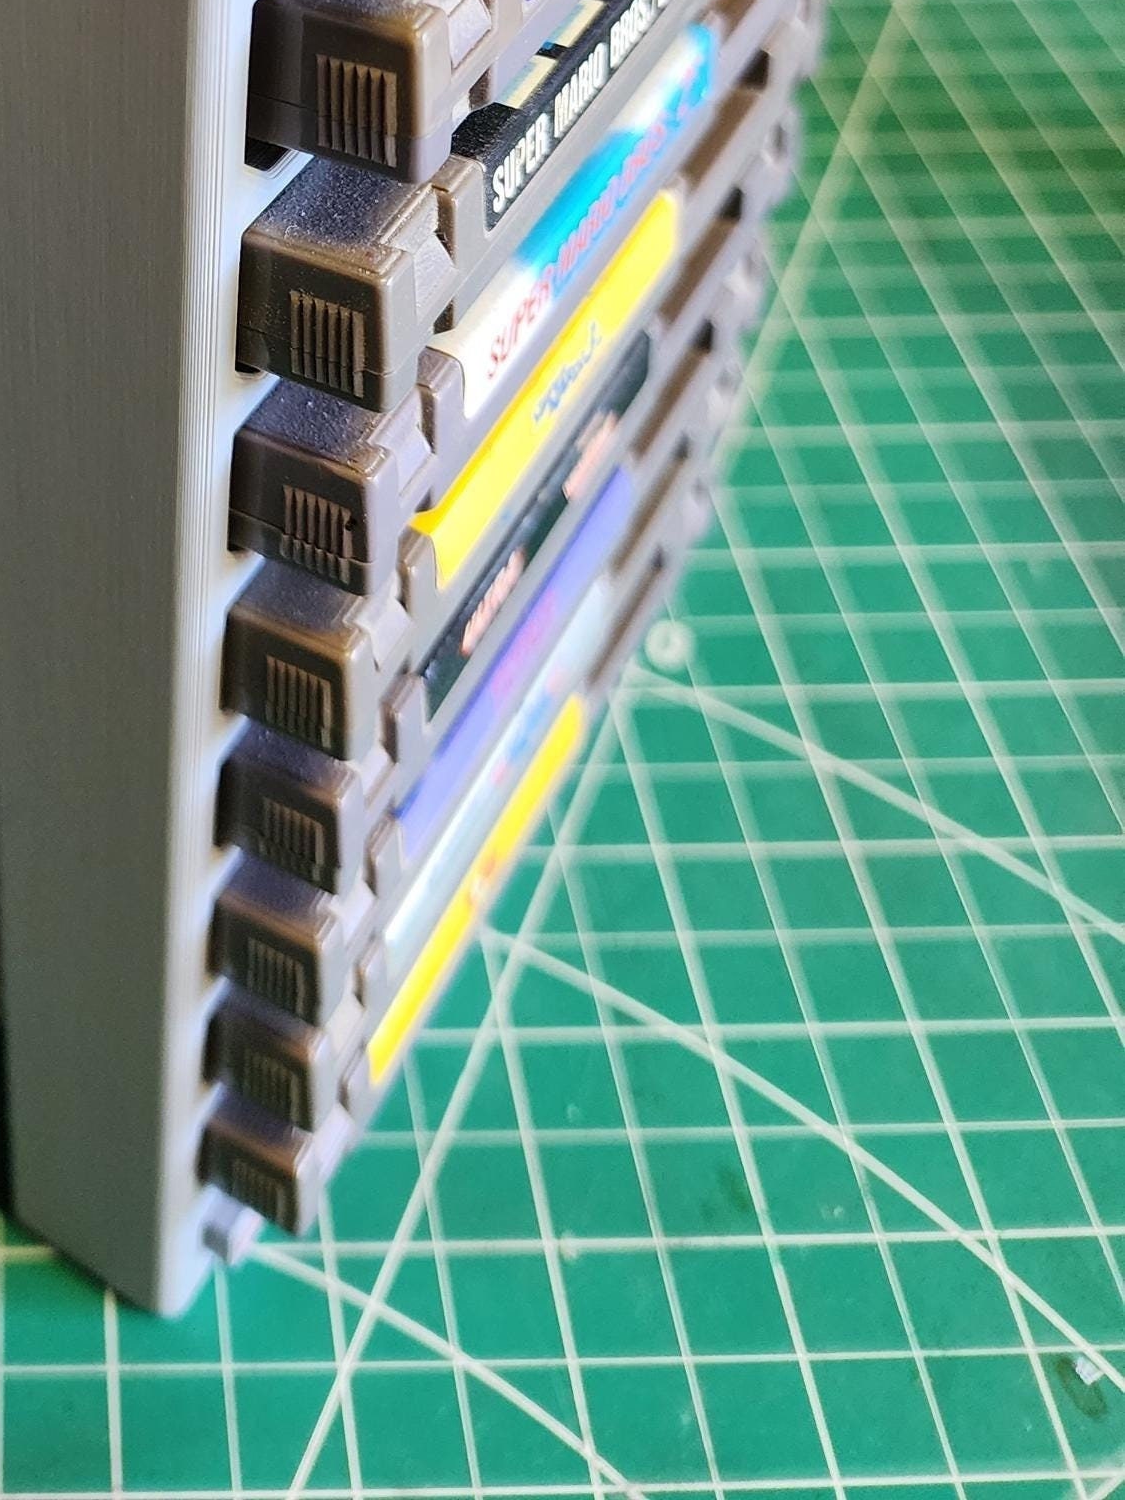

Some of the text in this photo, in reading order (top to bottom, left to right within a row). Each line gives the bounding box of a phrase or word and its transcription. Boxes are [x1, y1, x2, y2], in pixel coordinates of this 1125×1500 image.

[492, 113, 552, 213] SUPER
[554, 42, 609, 138] MARIO
[487, 263, 553, 379] SUPER
